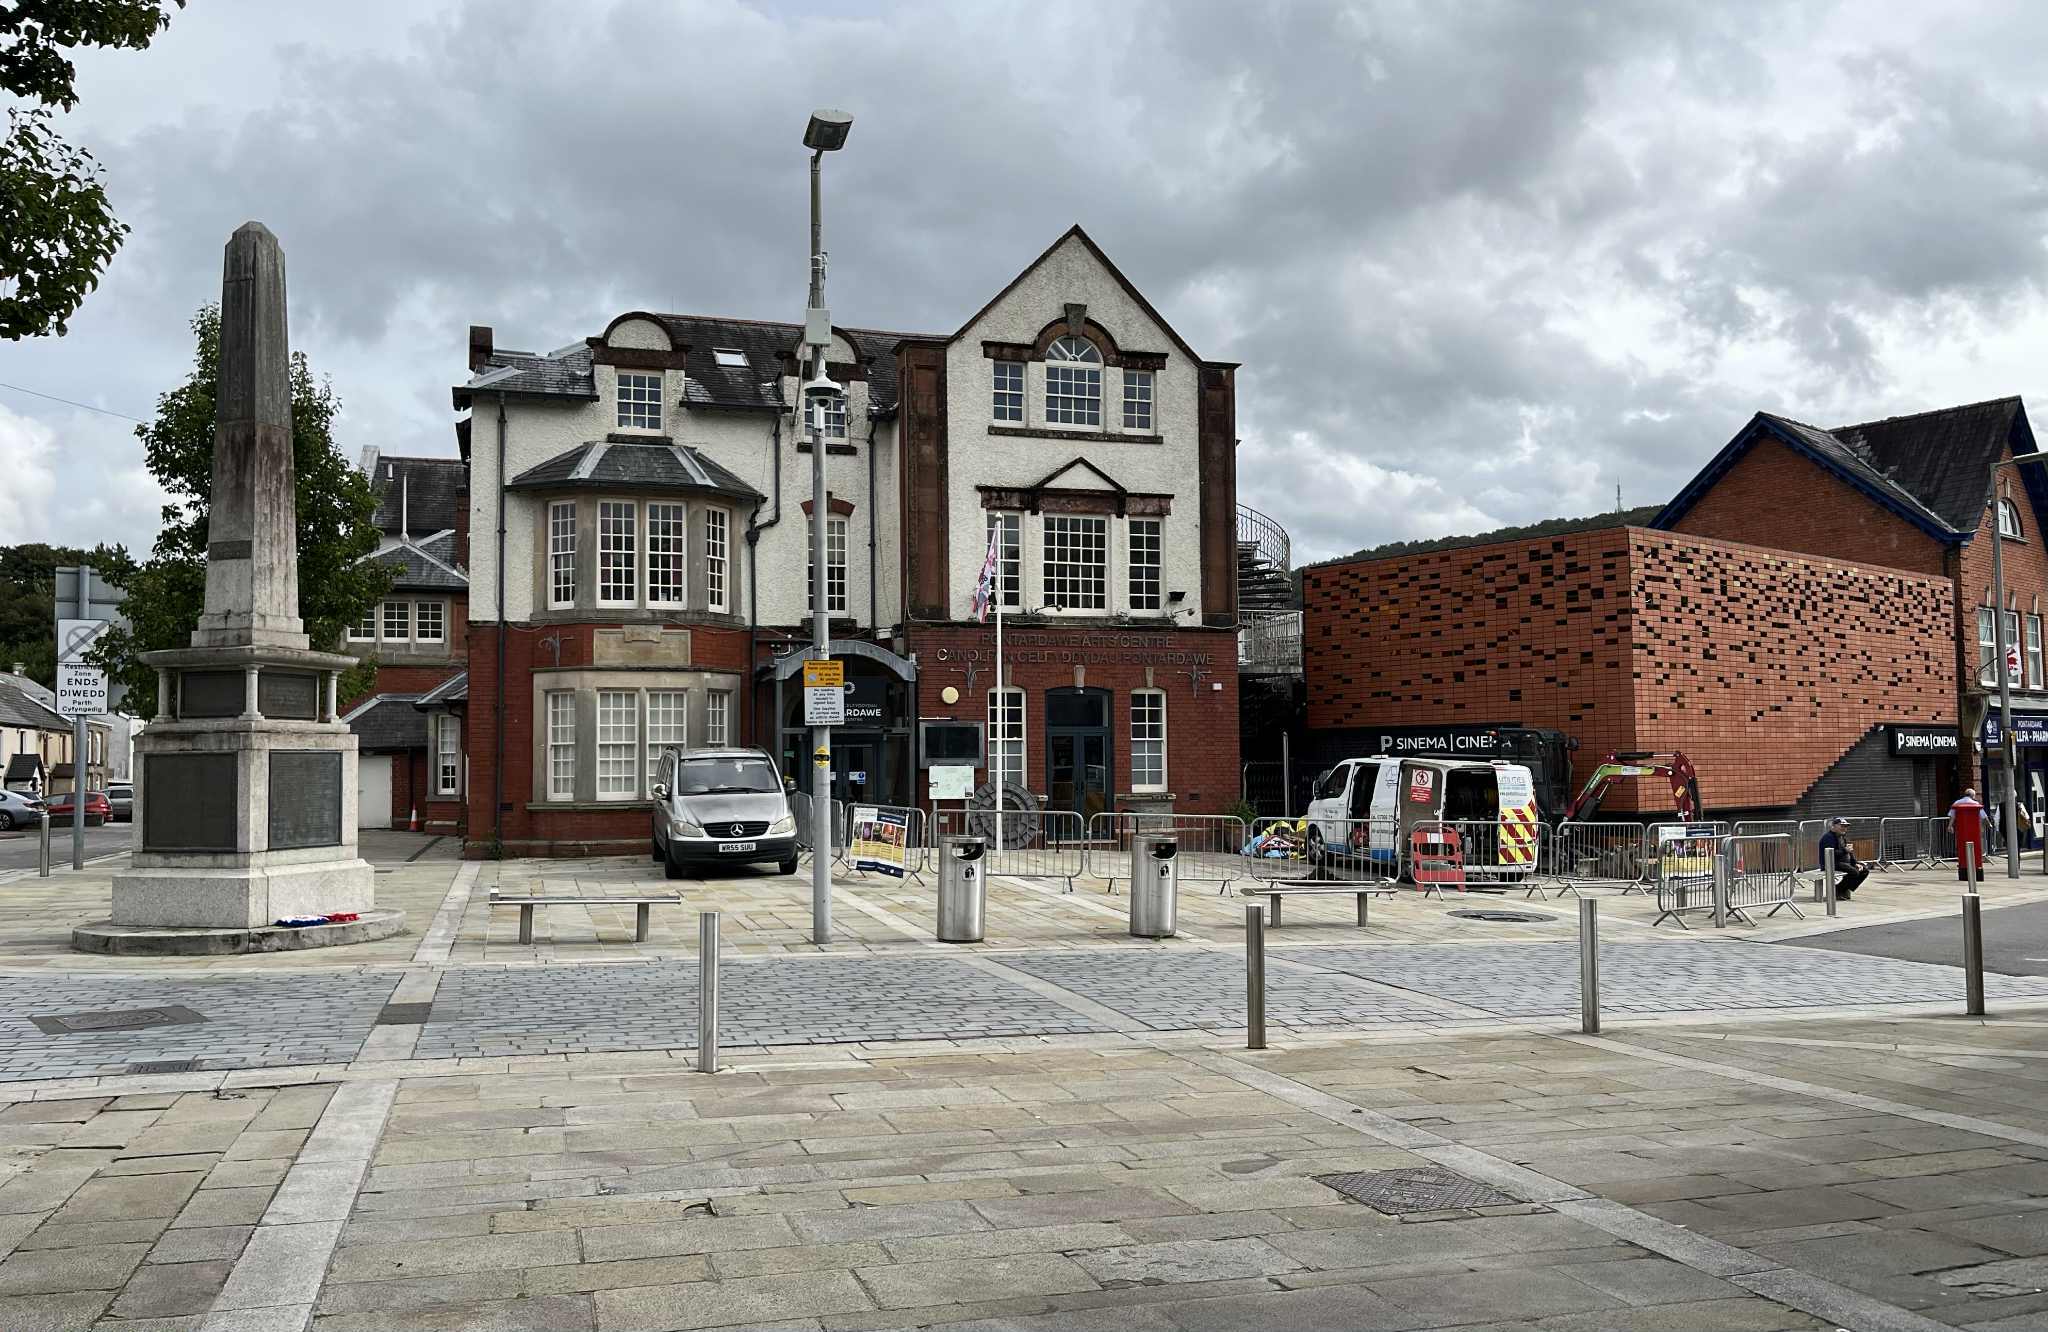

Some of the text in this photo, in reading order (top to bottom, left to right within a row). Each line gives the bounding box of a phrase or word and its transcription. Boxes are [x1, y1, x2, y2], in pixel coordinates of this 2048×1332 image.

[1120, 635, 1178, 649] CENTRE
[67, 678, 99, 686] ENDS
[60, 689, 106, 698] DIWEDD
[845, 708, 882, 717] RDAWE
[1396, 737, 1447, 750] SINEMA
[1905, 735, 1930, 747] SINEMA
[1932, 735, 1957, 747] CINEMA
